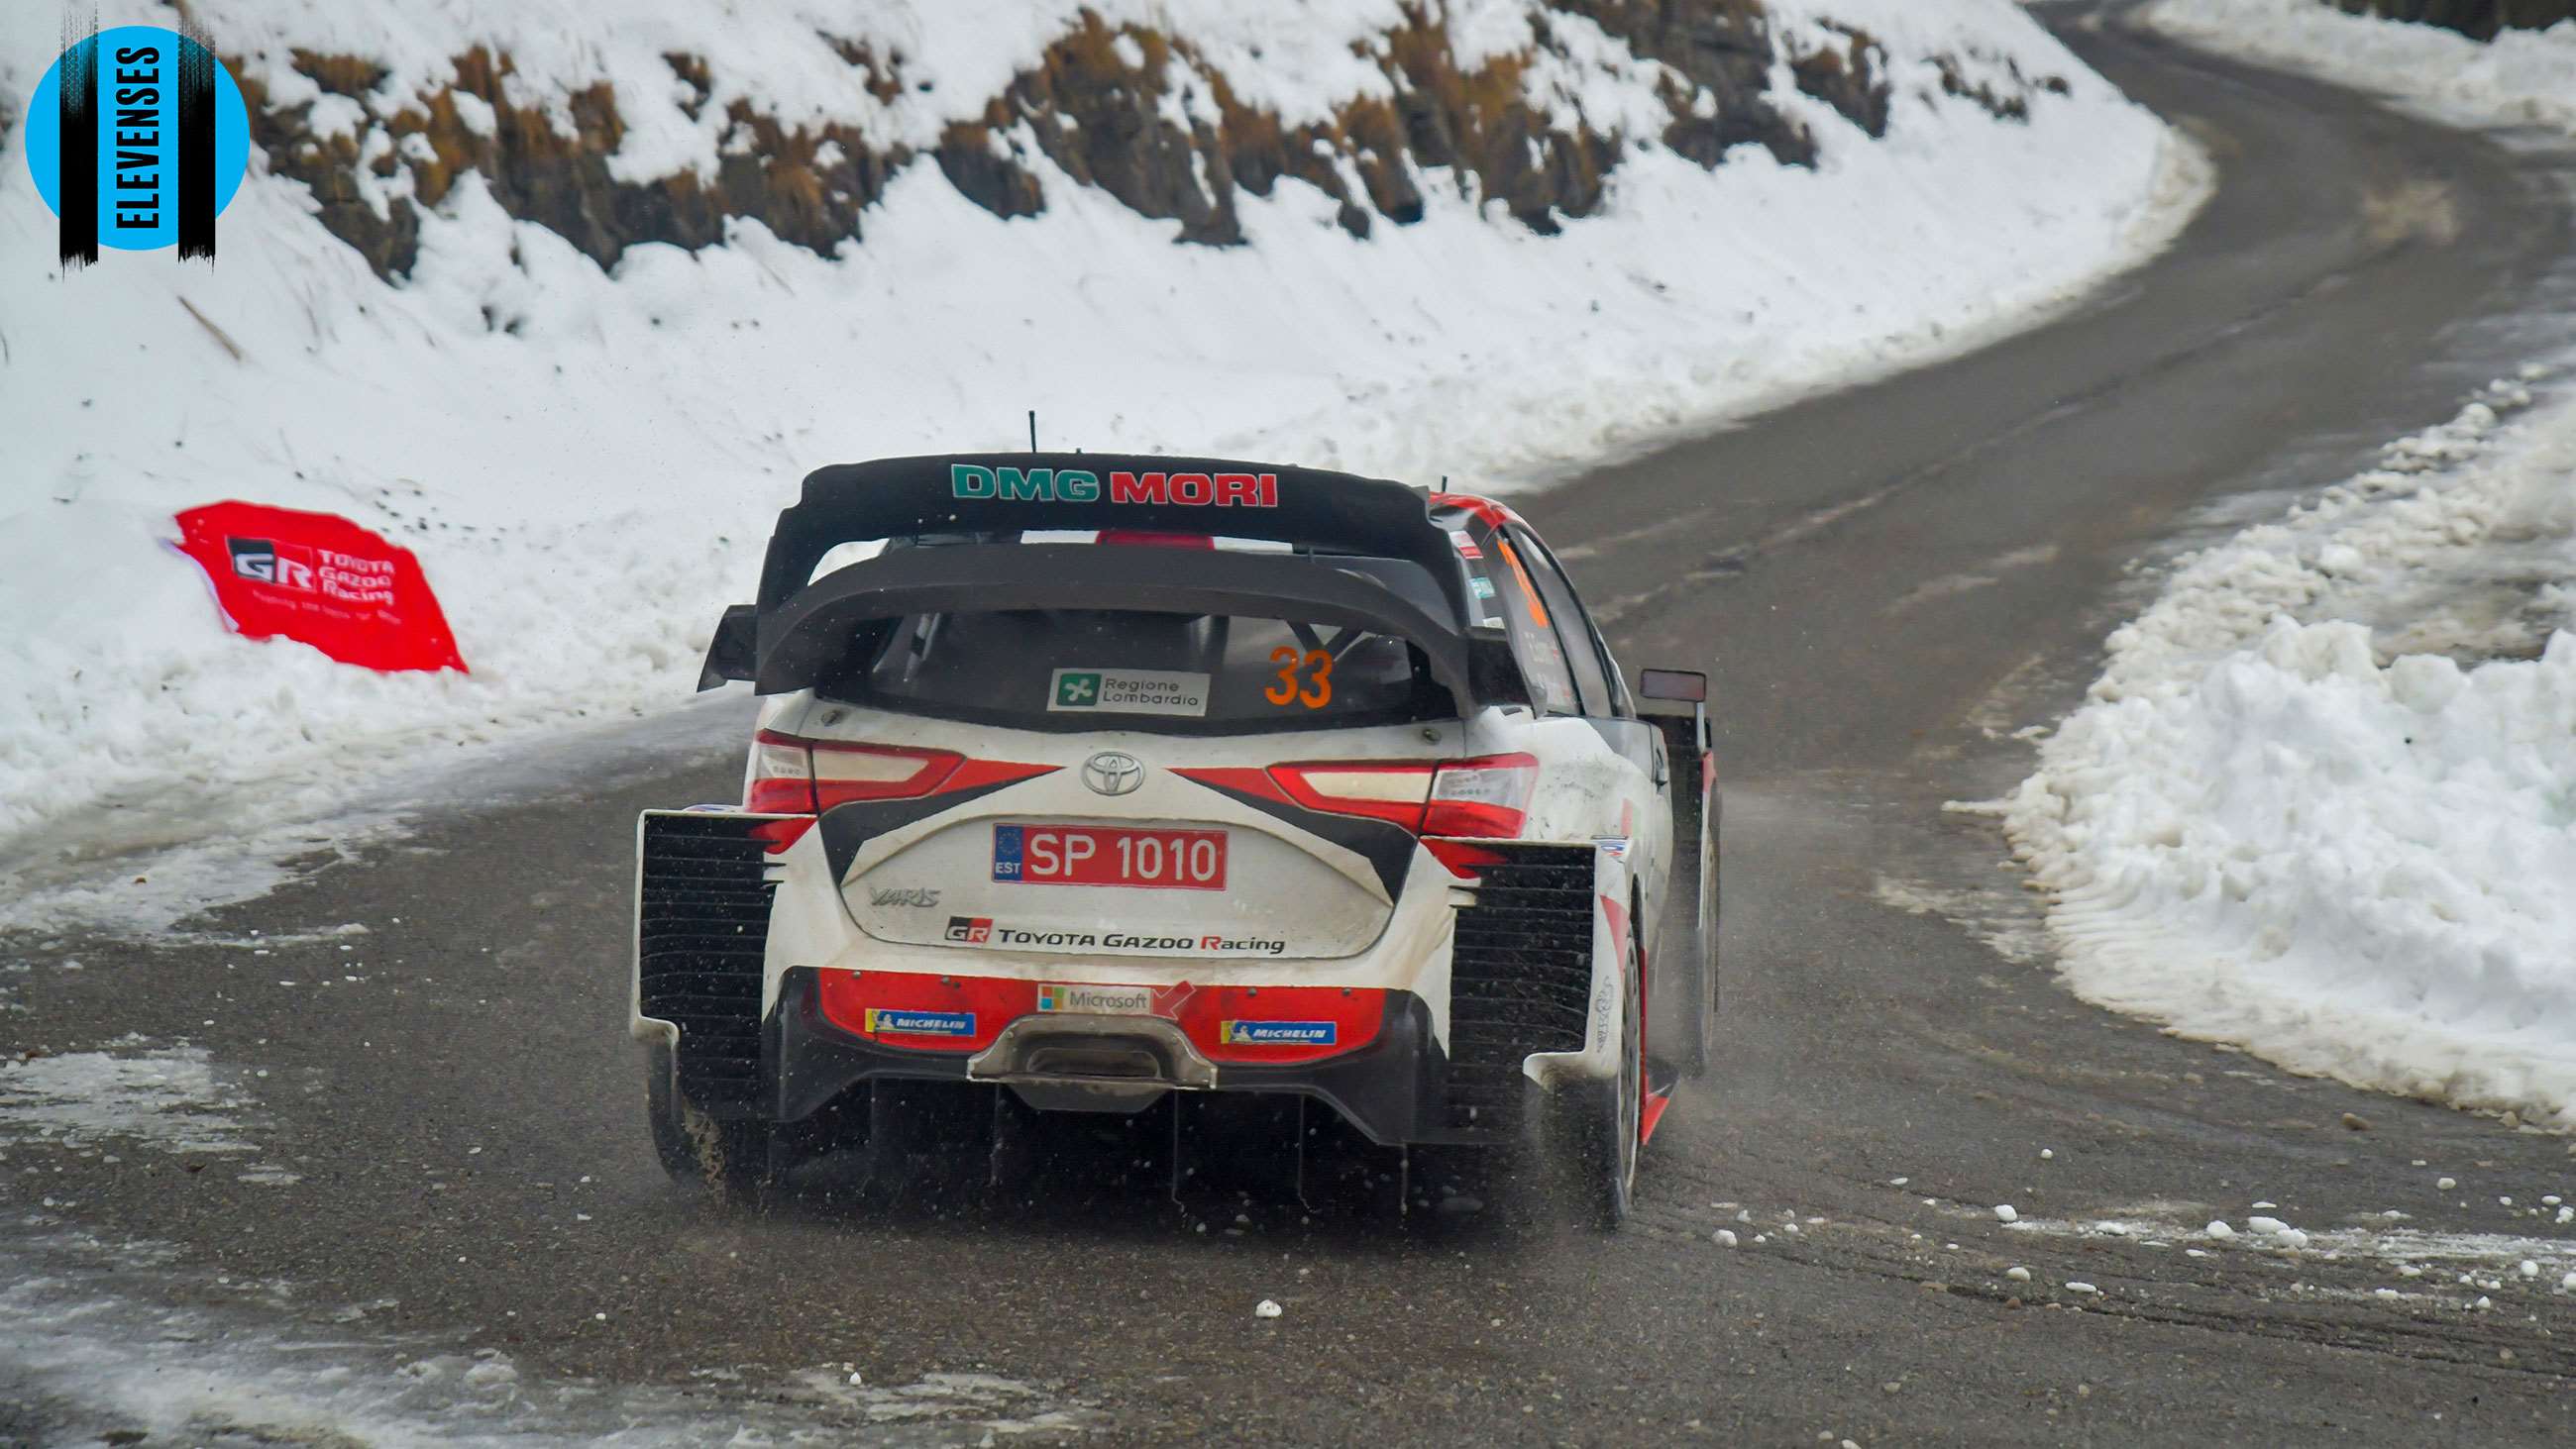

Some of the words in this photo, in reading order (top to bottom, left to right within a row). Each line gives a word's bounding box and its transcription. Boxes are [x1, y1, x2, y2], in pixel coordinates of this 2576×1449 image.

[951, 464, 1100, 502] DMG
[1110, 471, 1278, 507] MORI
[235, 553, 312, 589] GR
[317, 549, 394, 573] TOYOTA
[322, 579, 394, 605] Racing
[1105, 677, 1180, 692] Regione
[1264, 646, 1334, 709] 33
[1102, 692, 1199, 707] Lombardia
[995, 862, 1021, 875] EST
[1029, 833, 1097, 878] SP
[1117, 836, 1218, 881] 1010
[947, 926, 990, 942] GR
[998, 929, 1096, 946] TOYOTA
[1103, 934, 1195, 950] GAZOO
[1200, 936, 1286, 955] Racing
[1069, 990, 1148, 1009] Microsoft
[896, 1018, 968, 1030] MICHELIN
[1252, 1029, 1327, 1039] MICHELIN
